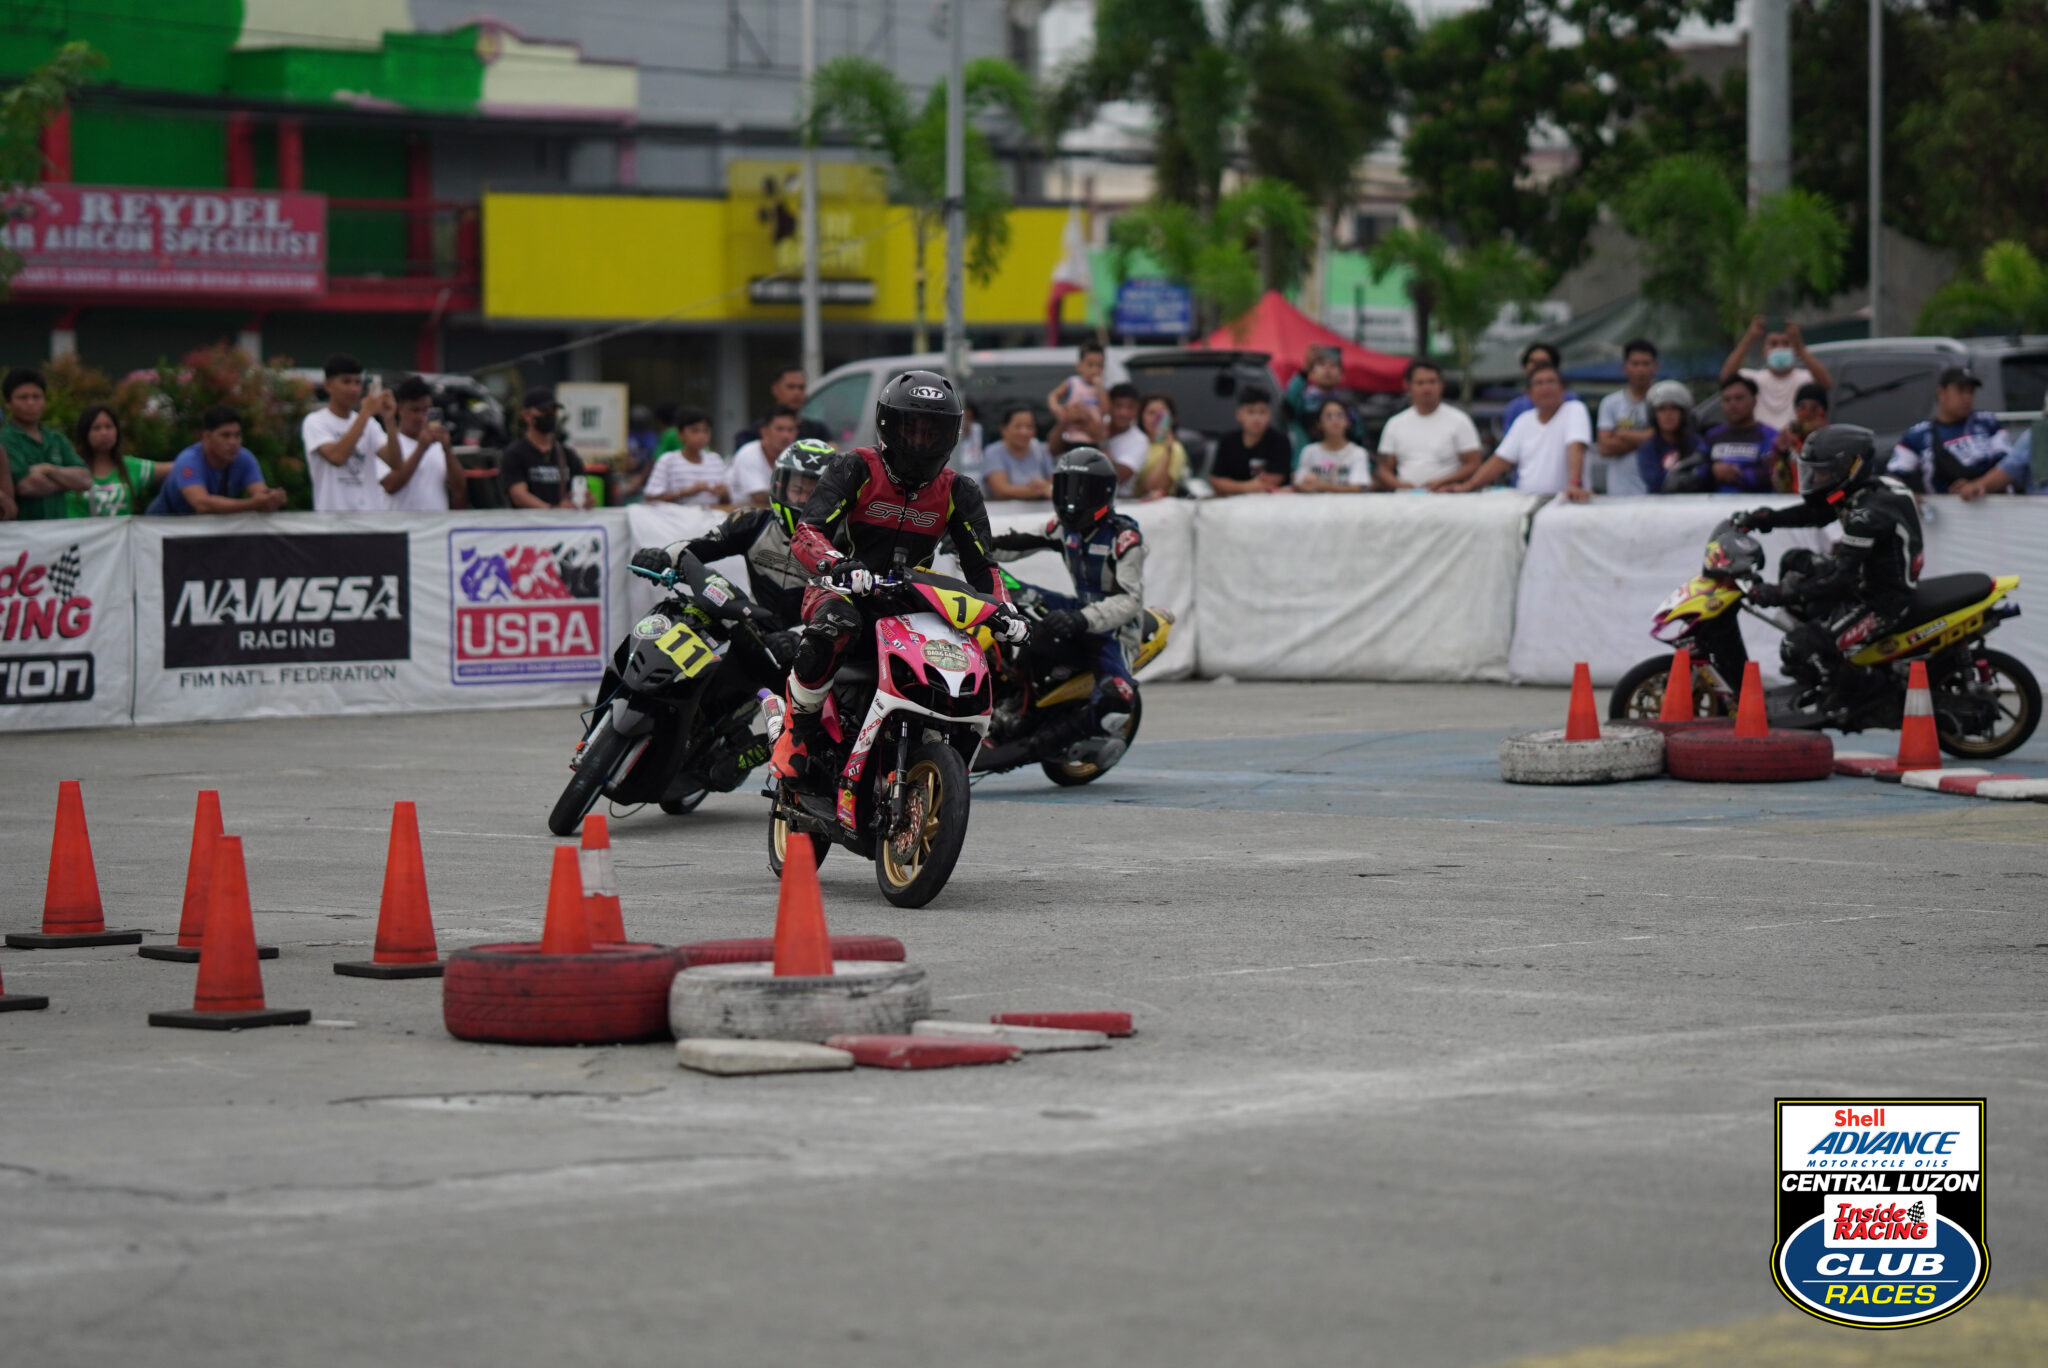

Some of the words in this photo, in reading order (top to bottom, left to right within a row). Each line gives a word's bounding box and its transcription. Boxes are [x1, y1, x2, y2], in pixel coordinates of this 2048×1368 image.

[79, 191, 293, 229] REYDEL
[44, 223, 153, 251] AIRCON
[162, 226, 319, 256] SPECIALIST
[913, 388, 942, 398] KYT
[171, 574, 402, 627] NAMSSA
[952, 596, 967, 624] 1
[0, 596, 92, 641] ING
[460, 610, 595, 656] USRA
[239, 628, 336, 650] RACING
[666, 629, 708, 671] 11
[179, 671, 215, 689] FIM
[280, 664, 397, 683] FEDERATION
